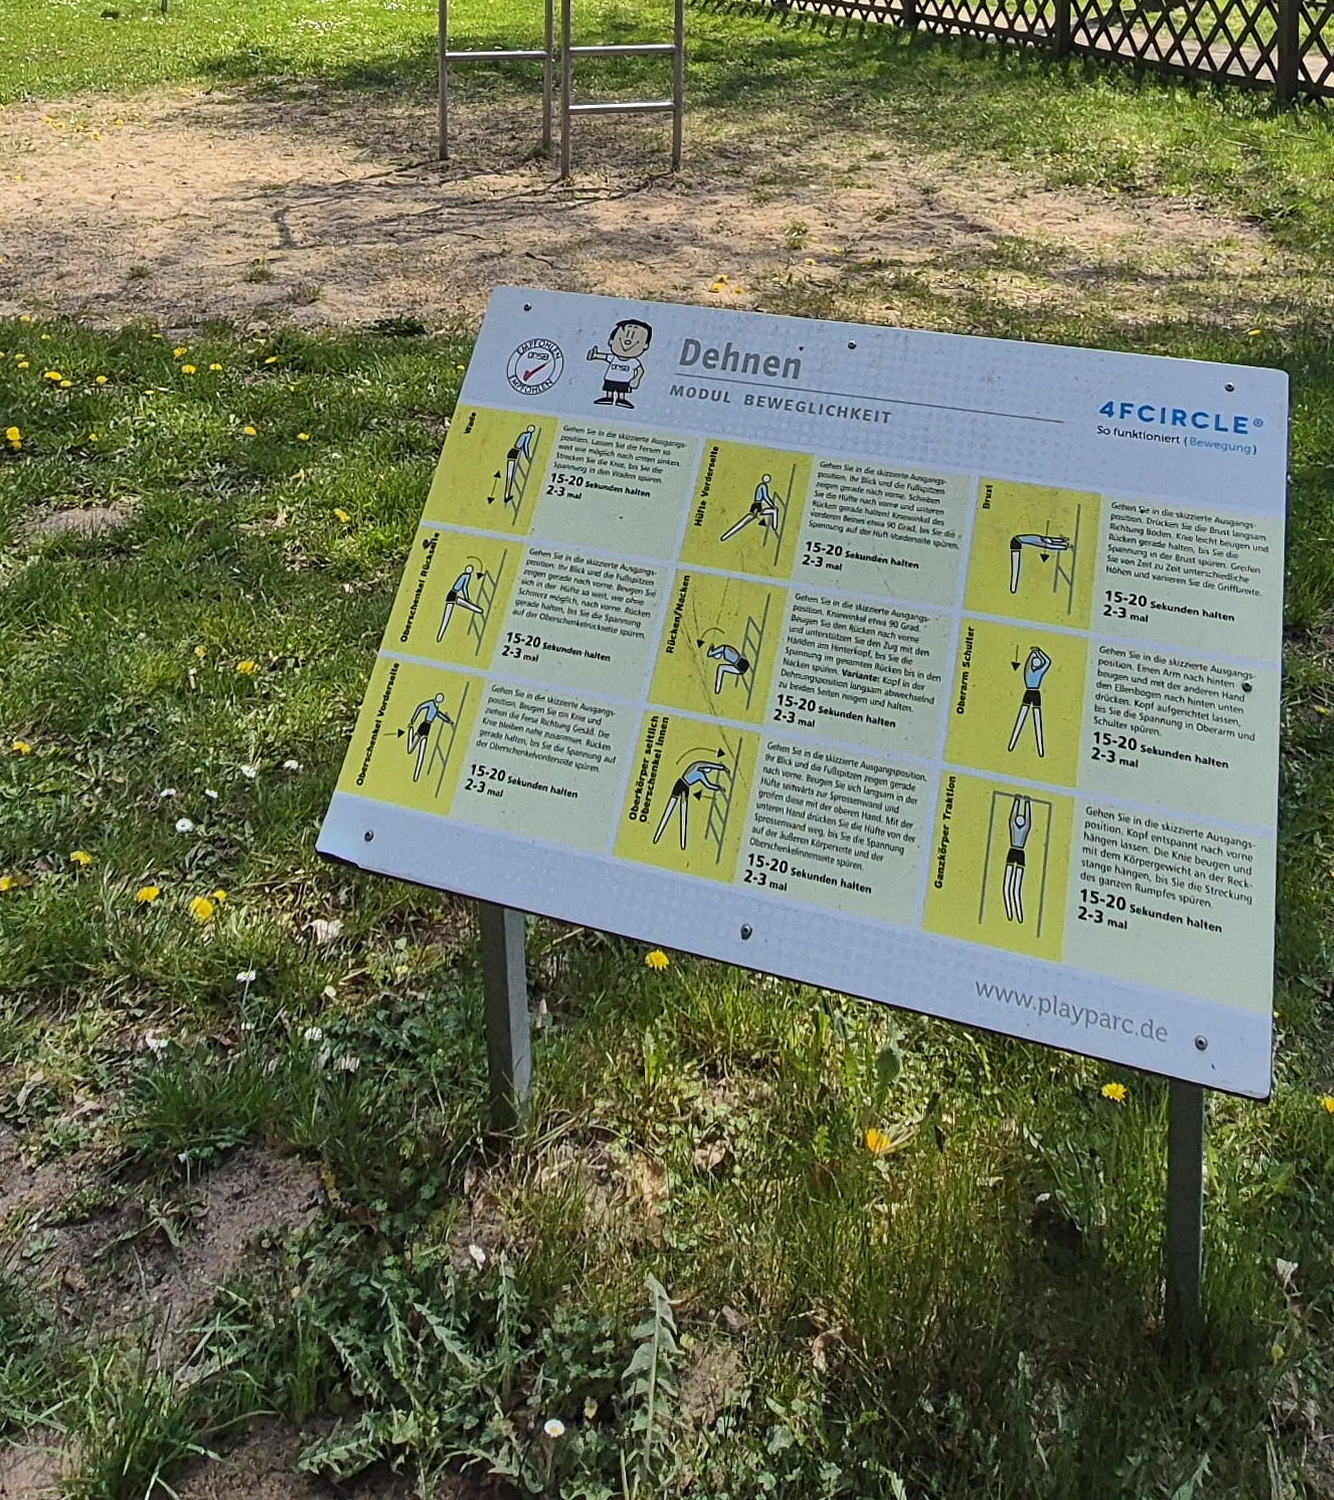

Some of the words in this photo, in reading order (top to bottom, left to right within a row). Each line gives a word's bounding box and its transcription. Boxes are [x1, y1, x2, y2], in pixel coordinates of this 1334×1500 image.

[678, 338, 803, 380] Dehnen
[669, 384, 731, 404] MODUL
[743, 394, 892, 424] BEWEGLICHKEIT
[1096, 425, 1111, 436] So
[1113, 427, 1180, 445] funktioniert
[545, 484, 566, 497] 2-3
[551, 472, 584, 487] 15-20
[693, 499, 707, 527] Hüfte
[700, 445, 720, 498] Vorderseite
[982, 484, 993, 510] Brust
[801, 554, 824, 568] 2-3
[825, 563, 843, 571] mal
[805, 540, 843, 557] 15-20
[844, 550, 889, 565] Sekunden
[890, 557, 920, 569] halten
[399, 579, 426, 643] Oberschenkel
[665, 575, 691, 654] Rücken/Nacken
[1103, 604, 1127, 619] 2-3
[1130, 614, 1149, 623] mal
[1105, 590, 1148, 608] 15-20
[1150, 600, 1200, 616] Sekunden
[1202, 609, 1235, 622] halten
[501, 645, 522, 659] 2-3
[506, 631, 541, 648] 15-20
[542, 642, 582, 657] Sekunden
[584, 649, 611, 662] halten
[961, 626, 975, 668] Schulter
[1098, 645, 1127, 658] Gehen
[1128, 650, 1141, 660] Sie
[1153, 655, 1167, 665] die
[1168, 658, 1209, 672] skizzierte
[841, 668, 880, 683] Variante:
[1097, 658, 1133, 671] position.
[1137, 663, 1161, 676] Einen
[1162, 668, 1181, 679] Arm
[1183, 673, 1204, 683] nach
[1206, 675, 1235, 688] hinten
[1097, 668, 1129, 682] beugen
[1130, 676, 1148, 685] und
[1150, 680, 1165, 689] mit
[1167, 681, 1181, 691] der
[1183, 685, 1220, 698] anderen
[1222, 691, 1245, 703] Hand
[956, 671, 970, 715] Oberarm
[1095, 680, 1112, 690] den
[1163, 694, 1185, 704] nach
[1187, 696, 1216, 710] hinten
[1217, 704, 1244, 714] unten
[1134, 699, 1154, 711] Kopf
[1156, 704, 1210, 721] aufgerichtet
[355, 719, 382, 786] Oberschenkel
[376, 662, 400, 717] Vorderseite
[773, 708, 796, 724] 2-3
[797, 719, 816, 728] mal
[777, 693, 816, 712] 15-20
[818, 705, 864, 722] Sekunden
[865, 714, 896, 728] halten
[1093, 703, 1107, 714] bis
[1108, 706, 1122, 717] Sie
[1123, 709, 1137, 720] die
[1138, 712, 1183, 730] Spannung
[1185, 722, 1194, 730] in
[1196, 722, 1235, 738] Oberarm
[1237, 732, 1256, 742] und
[1093, 715, 1128, 730] Schulter
[1090, 746, 1116, 763] 2-3
[1118, 758, 1139, 768] mal
[1093, 731, 1138, 751] 15-20
[1140, 744, 1192, 762] Sekunden
[1194, 754, 1229, 769] halten
[471, 763, 506, 782] 15-20
[506, 775, 549, 792] Sekunden
[549, 785, 578, 799] halten
[628, 757, 650, 821] Oberkörper
[644, 715, 659, 755] seitlich
[639, 748, 662, 823] Oberschenkel
[654, 716, 670, 747] Innen
[464, 778, 486, 793] 2-3
[486, 788, 504, 798] mal
[933, 823, 950, 889] Ganzkörper
[942, 775, 956, 821] Traktion
[1085, 806, 1115, 821] Gehen
[1117, 812, 1131, 824] Sie
[1132, 817, 1142, 826] in
[1144, 818, 1159, 829] die
[1161, 822, 1204, 839] skizzierte
[1083, 830, 1118, 847] hängen
[1153, 846, 1169, 858] Die
[1171, 850, 1192, 863] Knie
[1194, 854, 1231, 871] beugen
[1233, 865, 1252, 876] und
[1126, 827, 1149, 841] Kopf
[1150, 834, 1198, 851] entspannt
[1200, 845, 1224, 856] nach
[1226, 850, 1253, 863] vorne
[743, 869, 767, 886] 2-3
[769, 881, 788, 892] mal
[748, 853, 789, 874] 15-20
[790, 867, 838, 886] Sekunden
[840, 877, 872, 894] halten
[1082, 846, 1098, 857] mit
[1099, 848, 1121, 861] dem
[1123, 853, 1192, 877] Körpergewicht
[1193, 870, 1206, 879] an
[1208, 872, 1224, 883] der
[1080, 871, 1096, 883] des
[1098, 877, 1132, 890] ganzen
[1135, 882, 1176, 900] Rumpfes
[1081, 859, 1112, 874] stange
[1155, 873, 1168, 885] bis
[1171, 877, 1185, 889] Sie
[1187, 881, 1203, 893] die
[1205, 884, 1253, 906] Streckung
[1077, 905, 1104, 924] 2-3
[1107, 918, 1128, 930] mal
[1080, 888, 1127, 911] 15-20
[1129, 904, 1183, 925] Sekunden
[1186, 916, 1222, 933] halten
[975, 981, 1168, 1043] www.playparc.de
